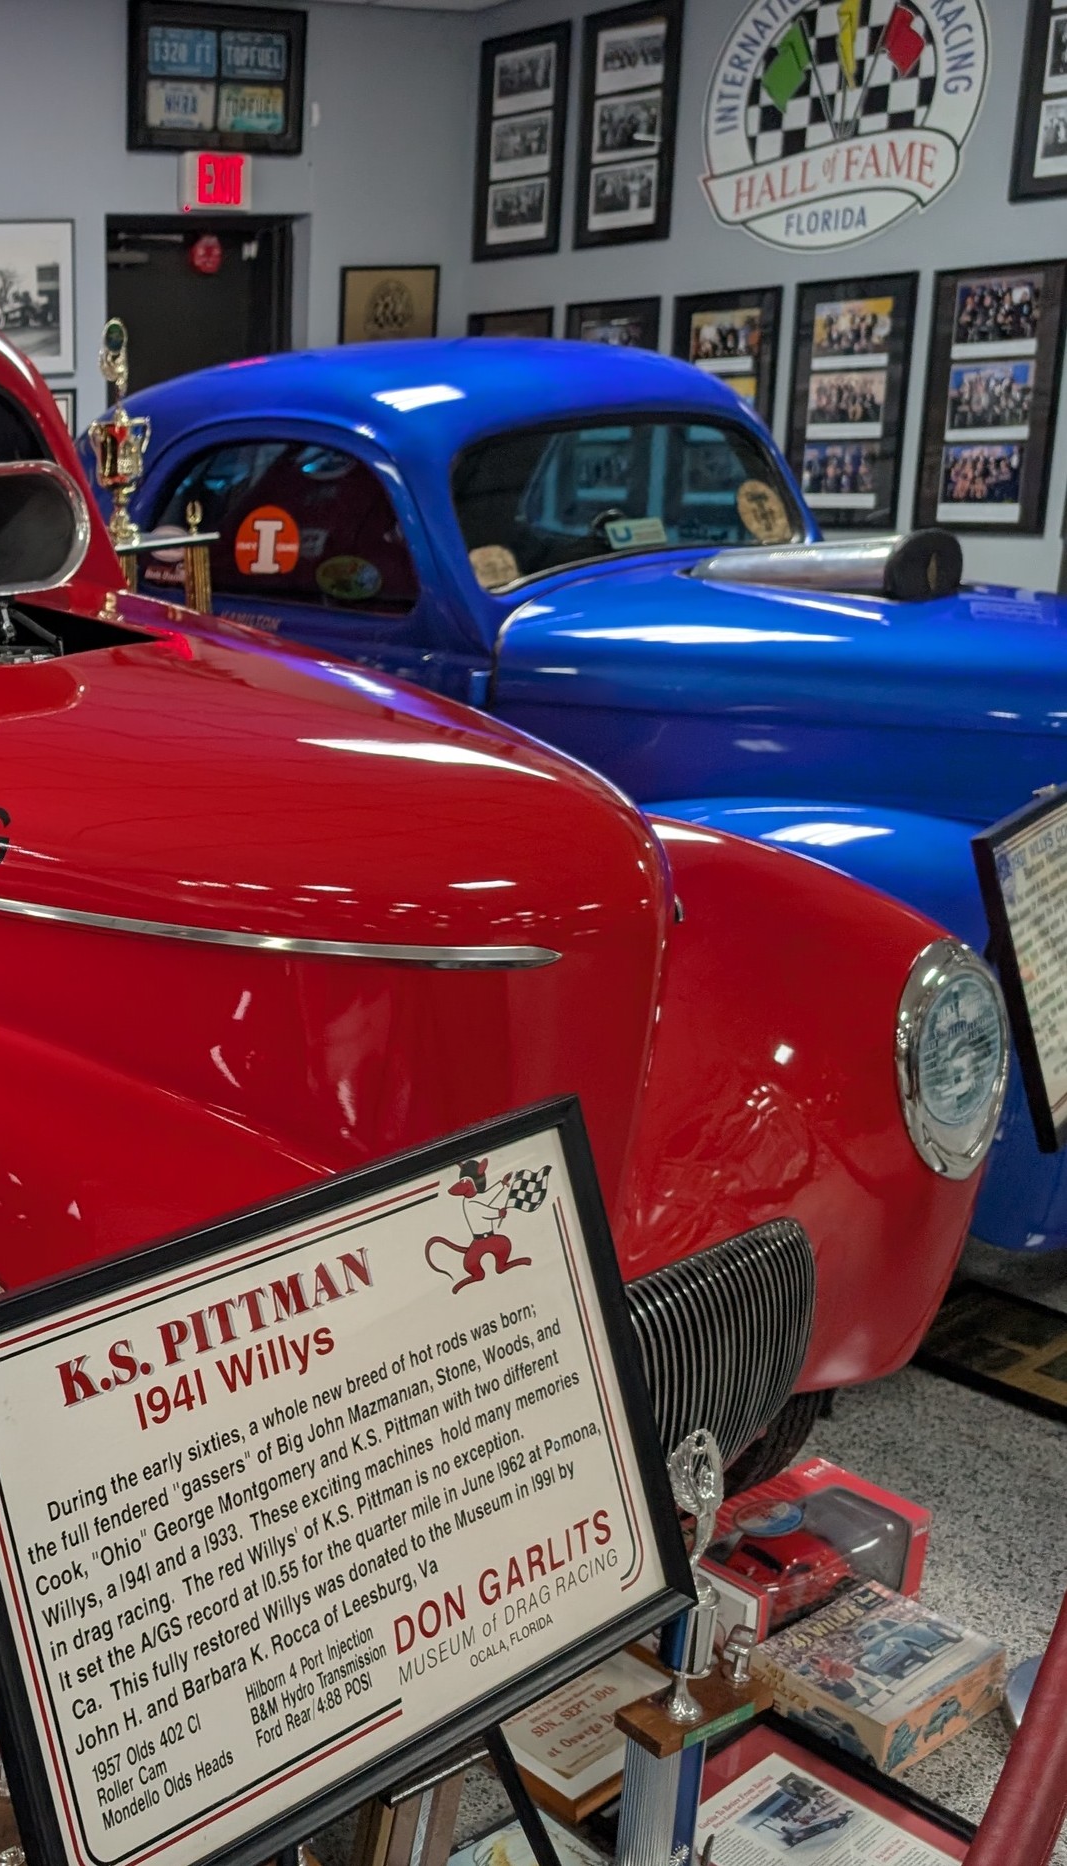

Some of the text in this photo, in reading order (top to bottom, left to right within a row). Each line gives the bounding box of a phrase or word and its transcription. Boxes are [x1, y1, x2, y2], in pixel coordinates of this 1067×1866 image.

[225, 45, 281, 68] TOPFUEL
[714, 0, 800, 136] INTERNATI
[197, 153, 244, 205] EXIT
[733, 141, 938, 215] HALL of FAME
[784, 206, 868, 236] FLORIDA
[54, 1246, 372, 1407] K.S. PITTMAN
[133, 1326, 334, 1430] 1941 Willys
[35, 1349, 559, 1595] Cook, "Ohio" George Montgomery K.S. Pittman with different
[46, 1303, 536, 1521] During the early sixties, whole breed of hot rods born;
[60, 1521, 89, 1550] full
[93, 1486, 169, 1536] fendered
[172, 1450, 250, 1502] "gassers"
[275, 1432, 303, 1455] Big
[307, 1415, 344, 1442] John
[435, 1358, 481, 1385] Stone,
[481, 1334, 534, 1364] Woods,
[536, 1317, 561, 1342] and
[40, 1371, 579, 1627] Willys, 1941 1933. These exciting machines hold many memories
[49, 1428, 524, 1661] in drag racing. The red Willys' K.S. Pittman exception.
[58, 1422, 601, 1691] It A/GS record 10.55 quarter mile June 1962 Pomona,
[71, 1460, 573, 1719] Ca. This fully restored Willys donated Museum 1991 by
[393, 1509, 611, 1655] DON GARLITS
[398, 1548, 617, 1685] MUSEUM DRAG RACING
[509, 1613, 553, 1645] FLORIDA
[75, 1558, 438, 1755] John H. Barbara K. Rocca Leesburg, Va
[244, 1627, 373, 1703] Hilborn 4 Port Injection
[249, 1644, 386, 1725] B&M Hydro Transmission
[254, 1718, 283, 1747] Ford
[344, 1671, 372, 1699] POSI
[91, 1712, 201, 1782] 1957 Olds 402 CI
[96, 1760, 167, 1807] Roller Cam
[101, 1749, 233, 1830] Mondello Olds Heads
